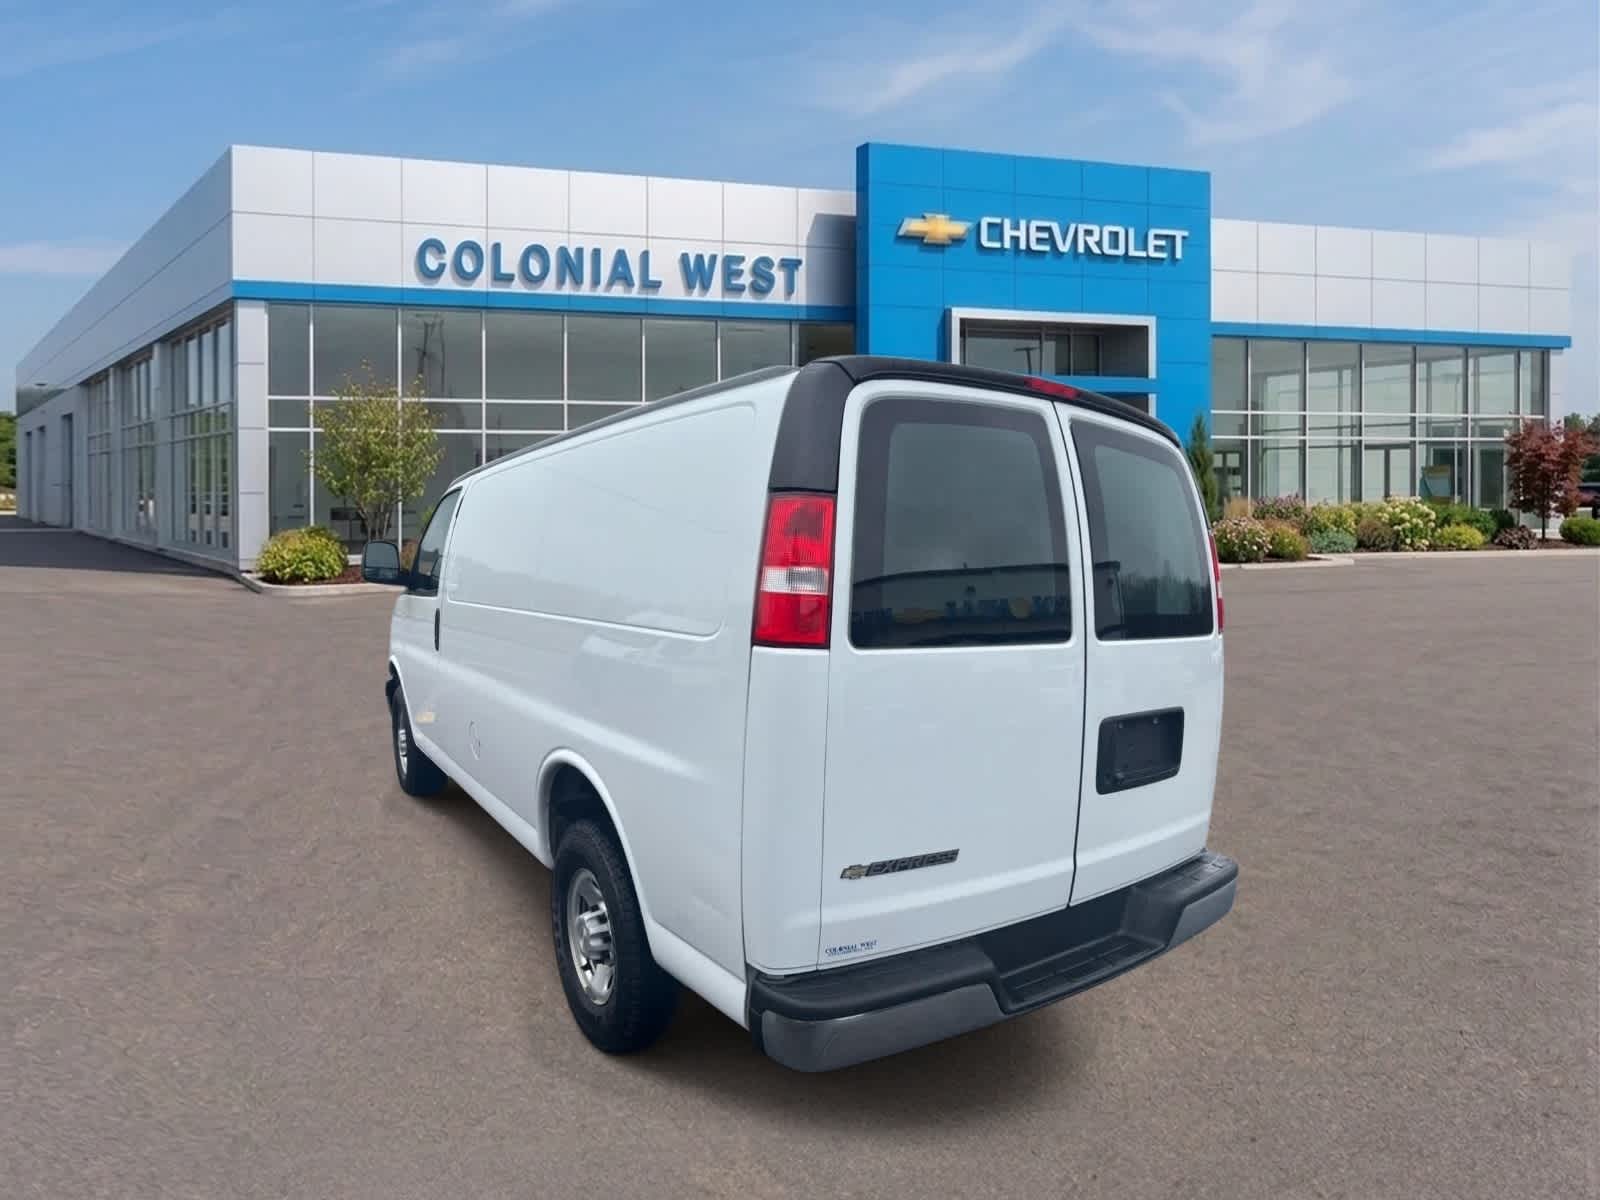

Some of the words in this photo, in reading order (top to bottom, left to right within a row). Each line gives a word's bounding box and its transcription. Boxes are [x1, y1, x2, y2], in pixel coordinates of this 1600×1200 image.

[979, 216, 1190, 260] CHEVROLET
[415, 237, 663, 290] COLONIAL
[679, 252, 803, 296] WEST
[867, 848, 960, 876] EXPRESS
[825, 943, 857, 954] COLONIAL
[860, 939, 877, 948] WEST
